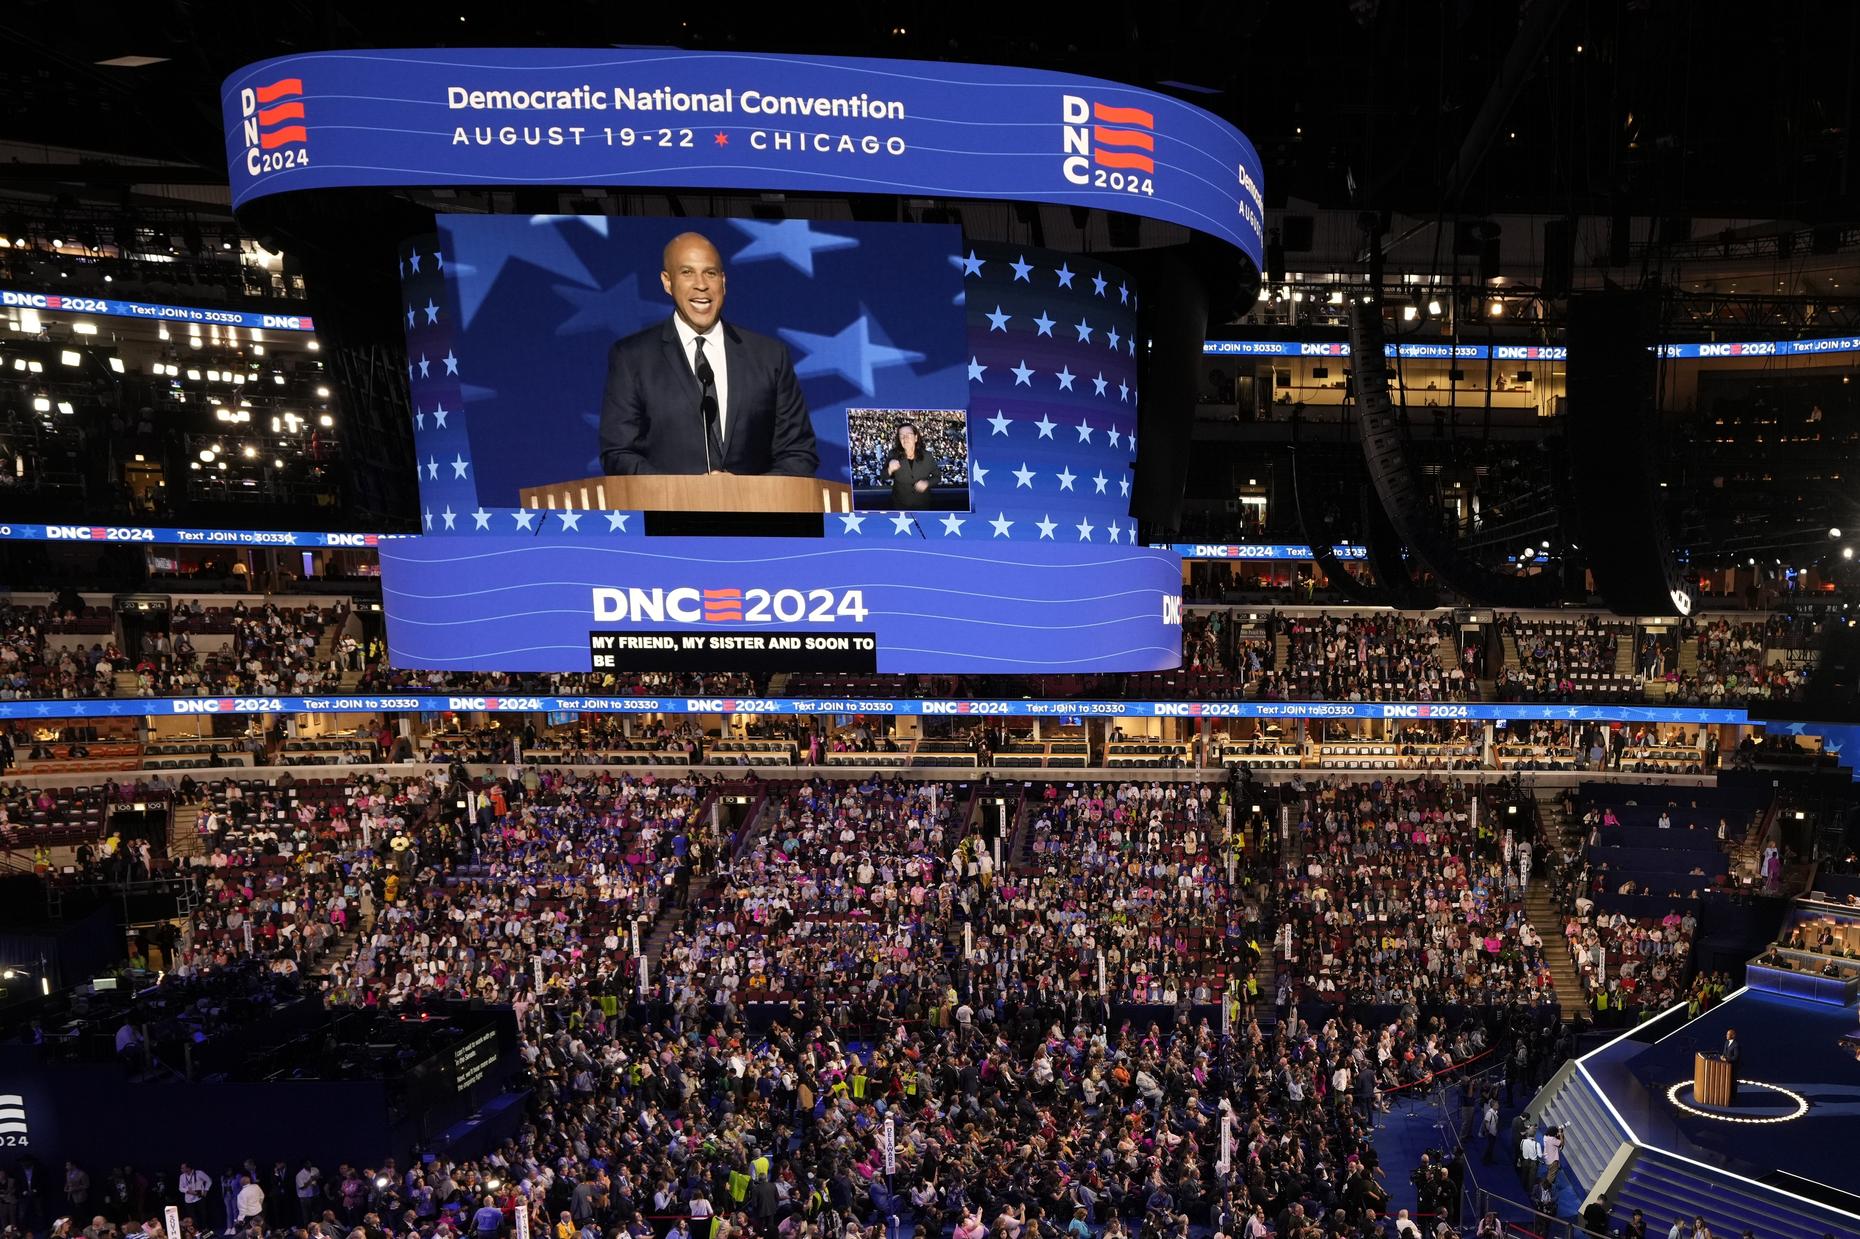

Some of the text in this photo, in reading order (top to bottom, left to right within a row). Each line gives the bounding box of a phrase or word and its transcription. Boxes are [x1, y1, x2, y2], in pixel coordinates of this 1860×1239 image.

[448, 85, 905, 119] Democratic National Convention
[241, 87, 261, 176] DNC
[452, 127, 906, 155] AUGUST 19-22 CHICAGO
[1062, 94, 1090, 185] DNC
[262, 148, 309, 173] 2024
[1094, 169, 1154, 196] 2024
[2, 291, 300, 329] DNC 2024 Text JOIN to 30330 DNC
[1203, 343, 1217, 351] ext
[1219, 343, 1241, 351] JOIN
[1253, 344, 1282, 353] 30330
[1301, 343, 1330, 355] DNC
[1438, 347, 1447, 355] to
[1498, 347, 1527, 359] DNC
[1700, 344, 1731, 356] DNC
[1741, 343, 1775, 355] 2024
[1793, 342, 1814, 351] Text
[1815, 341, 1838, 350] JOIN
[1841, 339, 1850, 348] to
[46, 526, 91, 539] DNC
[107, 527, 155, 541] 2024
[178, 531, 204, 541] Text
[206, 531, 237, 541] JOIN
[239, 532, 252, 542] to
[255, 532, 292, 543] 30330
[327, 533, 365, 546] DNC
[1196, 545, 1227, 557] DNC
[1239, 546, 1273, 557] 2024
[1286, 547, 1306, 556] Text
[1333, 548, 1342, 556] to
[592, 587, 869, 622] DNC 2024
[592, 637, 874, 651] MY FRIEND, MY SISTER AND SOON TO
[593, 655, 615, 667] BE
[173, 698, 1467, 718] DNC 2024 Text JOIN to 30330 DNC 2024 Text JOIN to 30330 DNC 2024 Text JOIN to 30330 DNC 2024 Text JOIN to 30330 DNC 2024 Text JOIN to 30330 DNC 2024
[886, 1127, 894, 1167] DELAWARE
